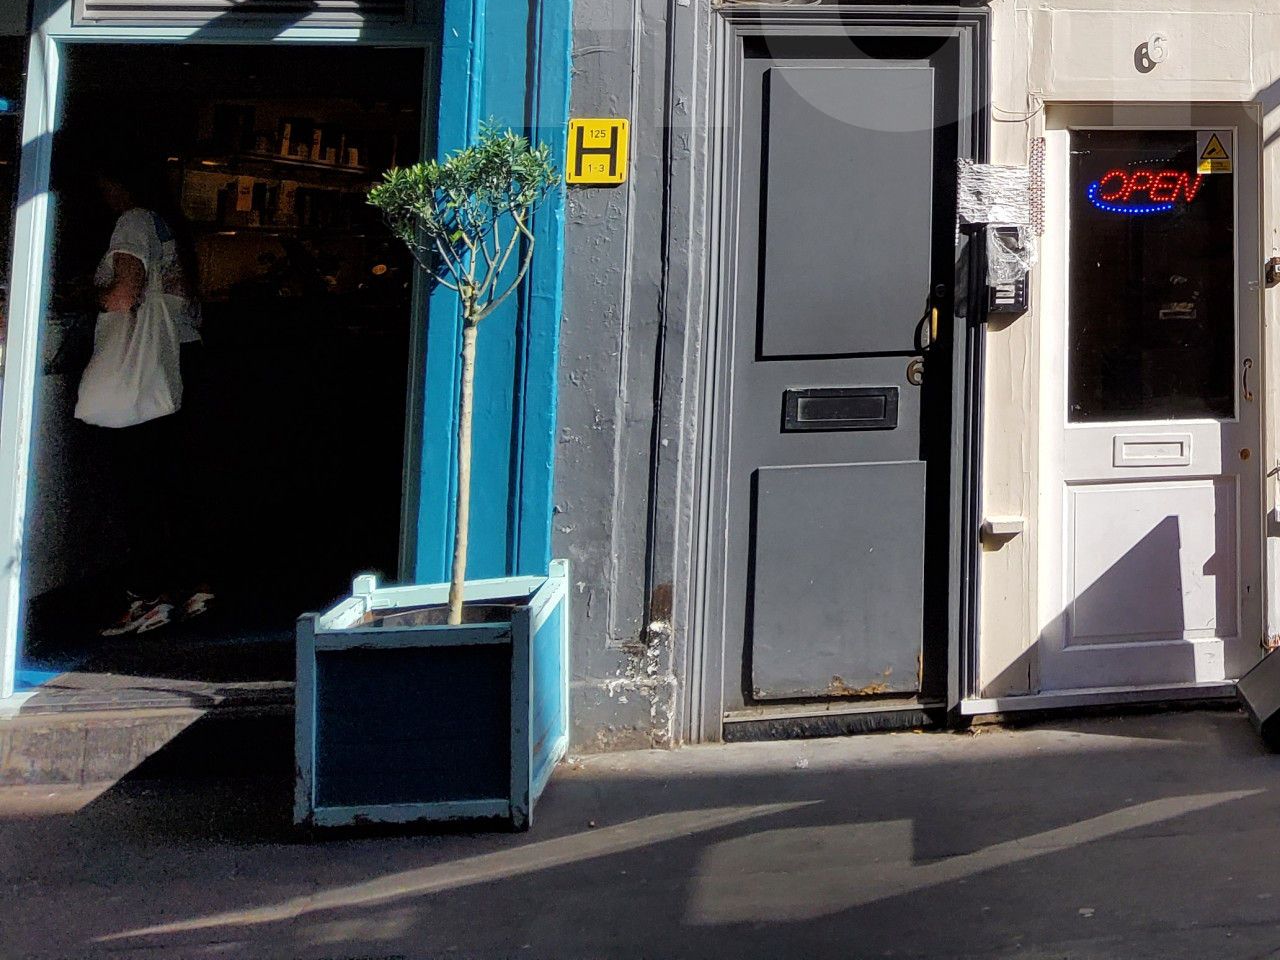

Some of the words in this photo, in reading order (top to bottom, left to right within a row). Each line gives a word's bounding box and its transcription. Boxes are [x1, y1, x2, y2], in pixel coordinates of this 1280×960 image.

[590, 129, 606, 139] 125
[574, 125, 619, 177] H
[1099, 169, 1205, 202] OPEN
